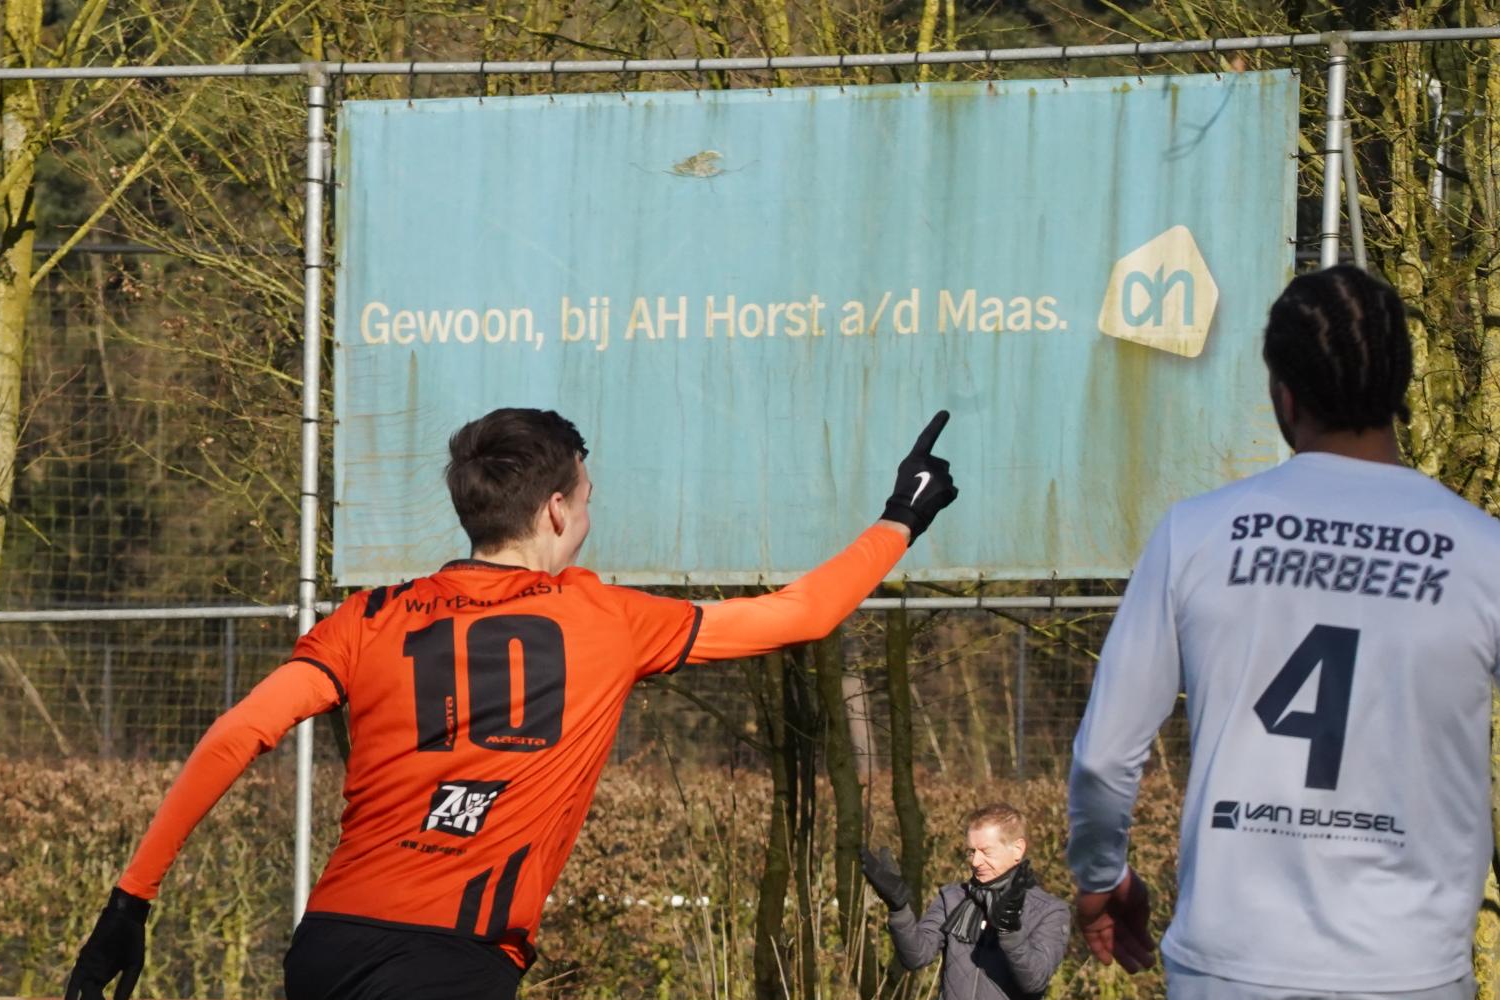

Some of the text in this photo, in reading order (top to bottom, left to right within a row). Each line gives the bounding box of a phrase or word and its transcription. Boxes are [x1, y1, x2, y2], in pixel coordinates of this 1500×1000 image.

[360, 288, 1069, 351] Gewoon, bij AH Horst a/d Maas.
[1230, 513, 1454, 560] SPORTSHOP
[1227, 546, 1450, 605] LAARBEEK
[403, 614, 566, 752] 10
[1253, 623, 1361, 791] 4
[1245, 803, 1405, 835] VAN BUSSEL
